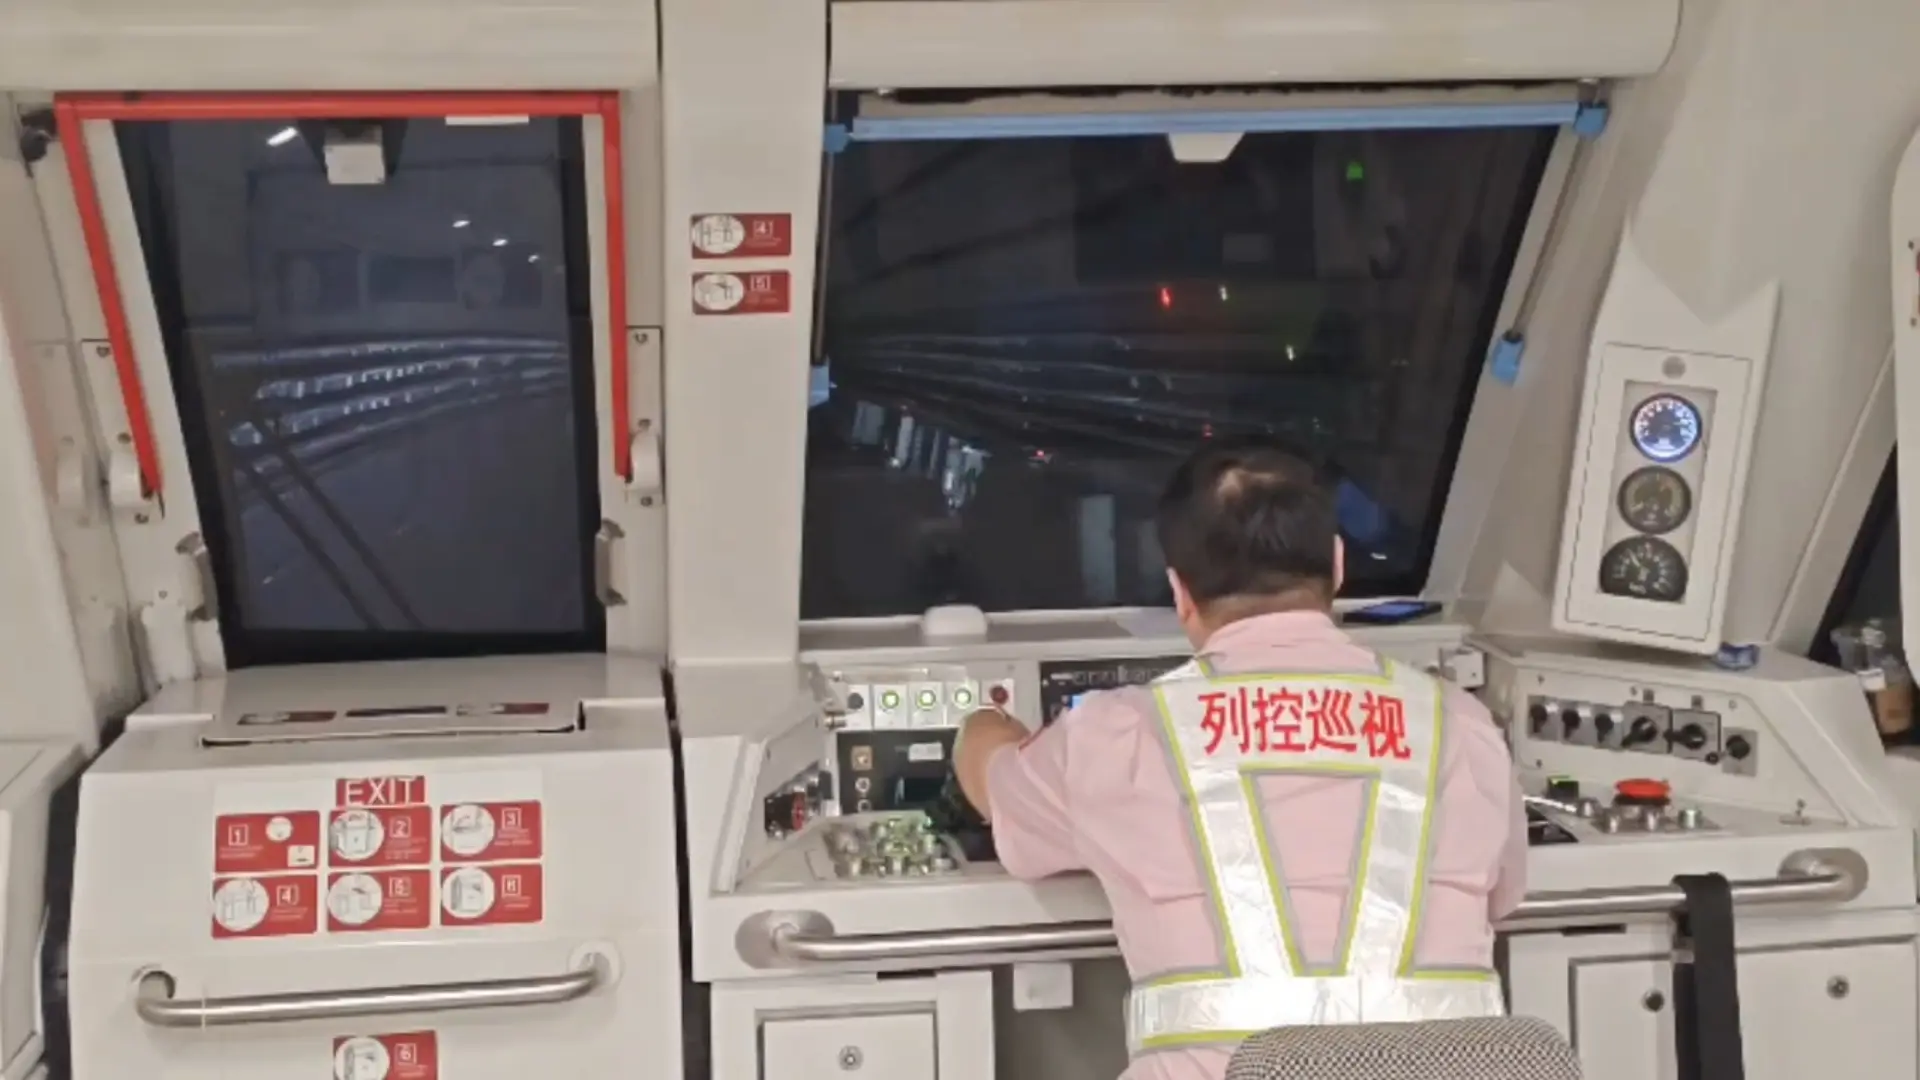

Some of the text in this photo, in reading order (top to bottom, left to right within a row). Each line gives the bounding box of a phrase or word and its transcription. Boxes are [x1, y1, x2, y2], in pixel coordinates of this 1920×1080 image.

[1198, 687, 1411, 759] 列控巡视
[345, 777, 416, 806] EXIT
